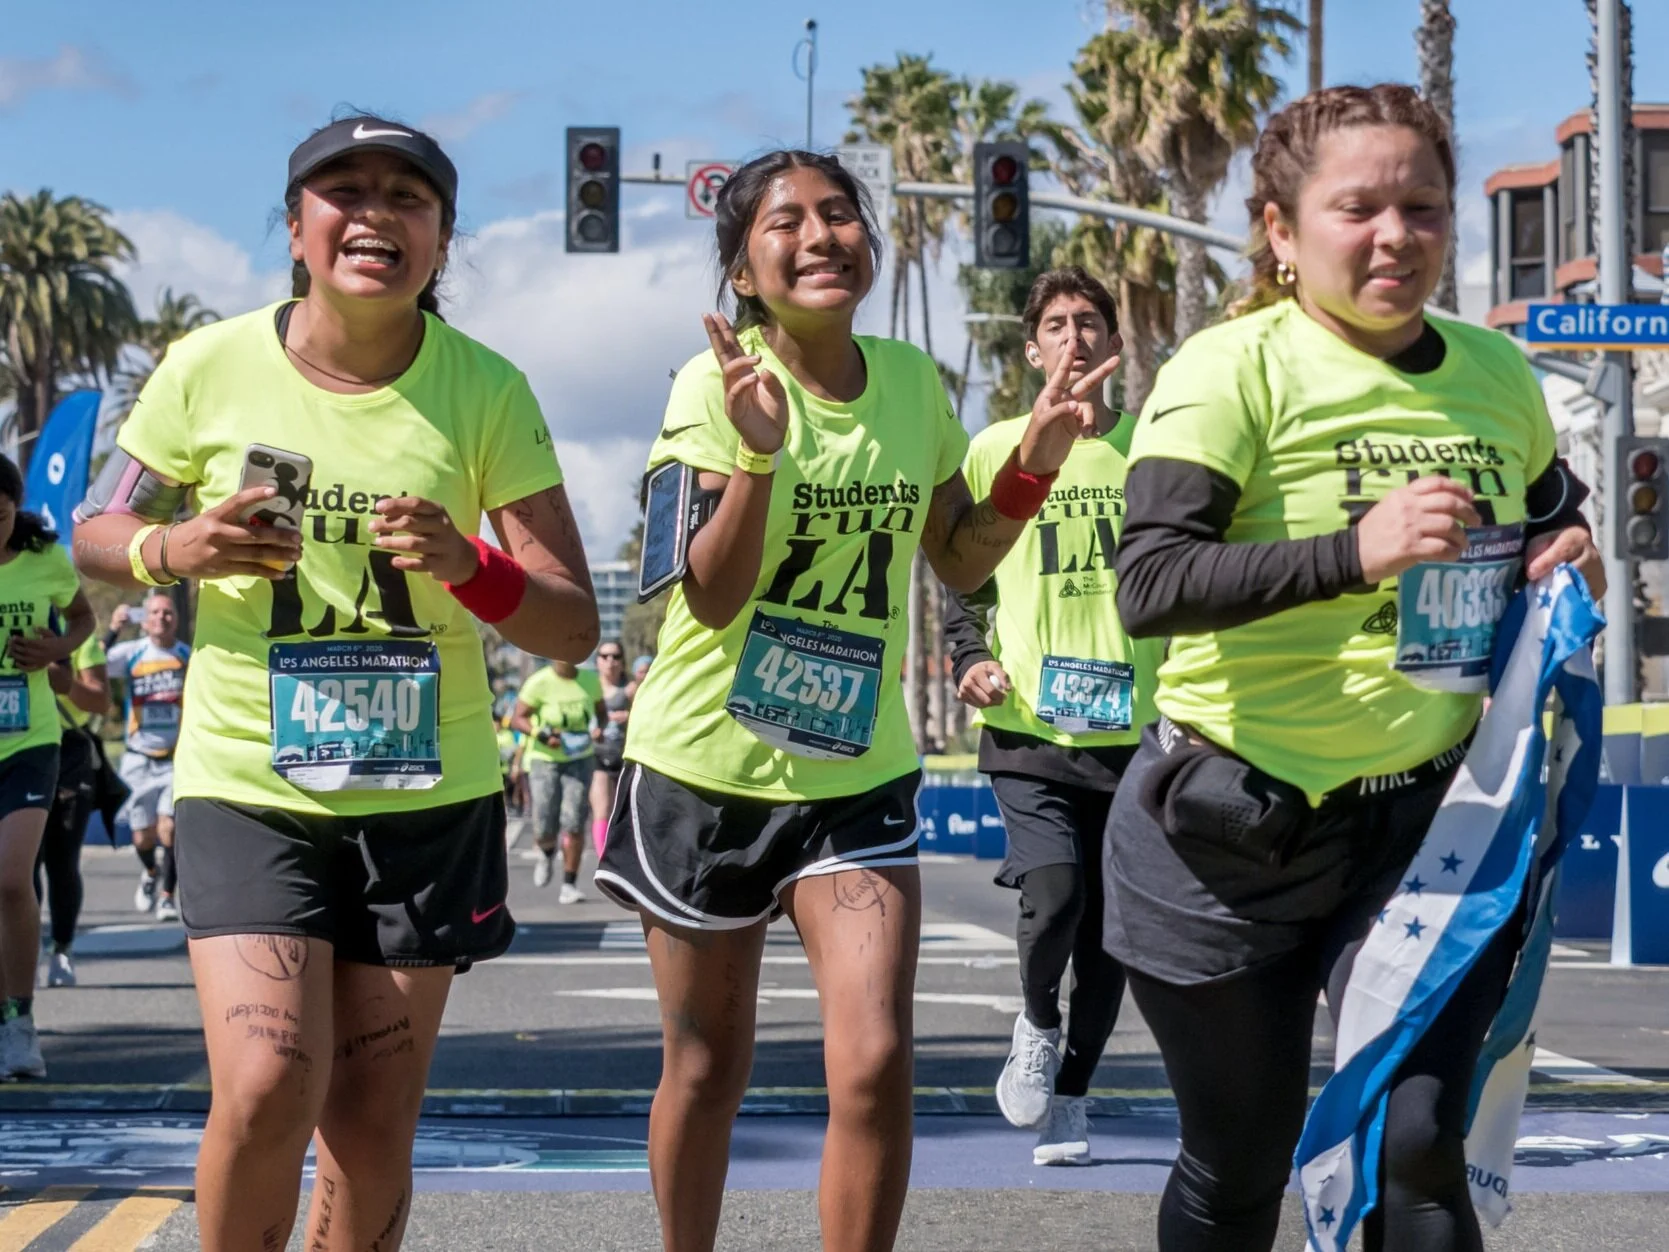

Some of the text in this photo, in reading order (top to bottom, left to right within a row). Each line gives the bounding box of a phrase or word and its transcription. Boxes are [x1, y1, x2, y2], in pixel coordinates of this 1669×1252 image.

[1536, 308, 1668, 336] Californ
[1334, 438, 1504, 466] Students
[792, 480, 920, 509] Students
[1047, 485, 1124, 502] tudents
[788, 504, 914, 537] run
[1036, 518, 1117, 576] LA
[755, 531, 894, 620] LA
[300, 655, 359, 668] ANGELES
[362, 655, 430, 668] MARATHON
[819, 643, 878, 663] MARATHON
[1060, 661, 1092, 671] ANGELES
[754, 645, 864, 714] 42537
[1050, 672, 1121, 710] 43374
[291, 678, 421, 733] 42540
